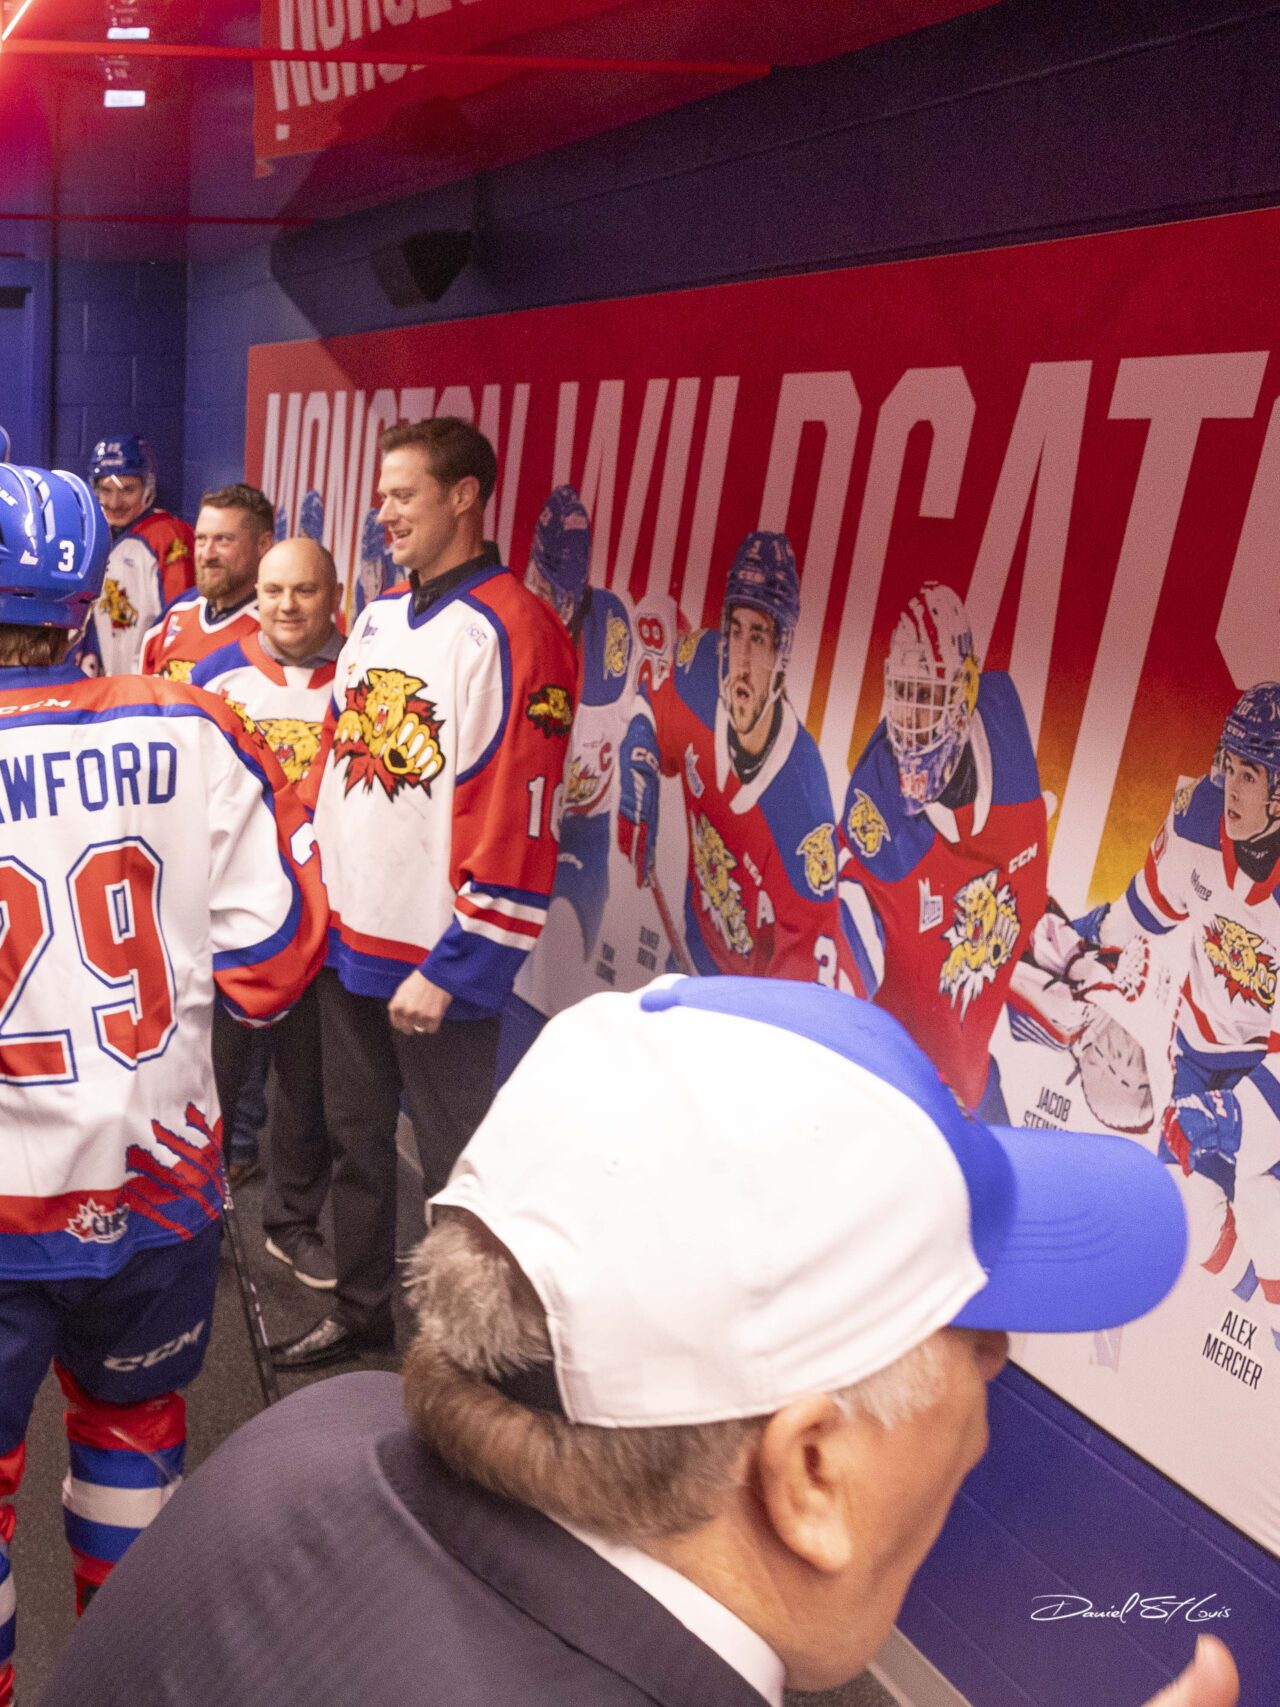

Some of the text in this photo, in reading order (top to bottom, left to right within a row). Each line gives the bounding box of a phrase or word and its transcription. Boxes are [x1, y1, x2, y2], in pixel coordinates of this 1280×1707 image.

[57, 540, 75, 572] 3
[1008, 842, 1038, 875] CCM
[1036, 1086, 1072, 1123] JACOB
[103, 1319, 206, 1372] CCM
[1220, 1309, 1258, 1351] ALEX
[1202, 1333, 1263, 1391] MERCIER
